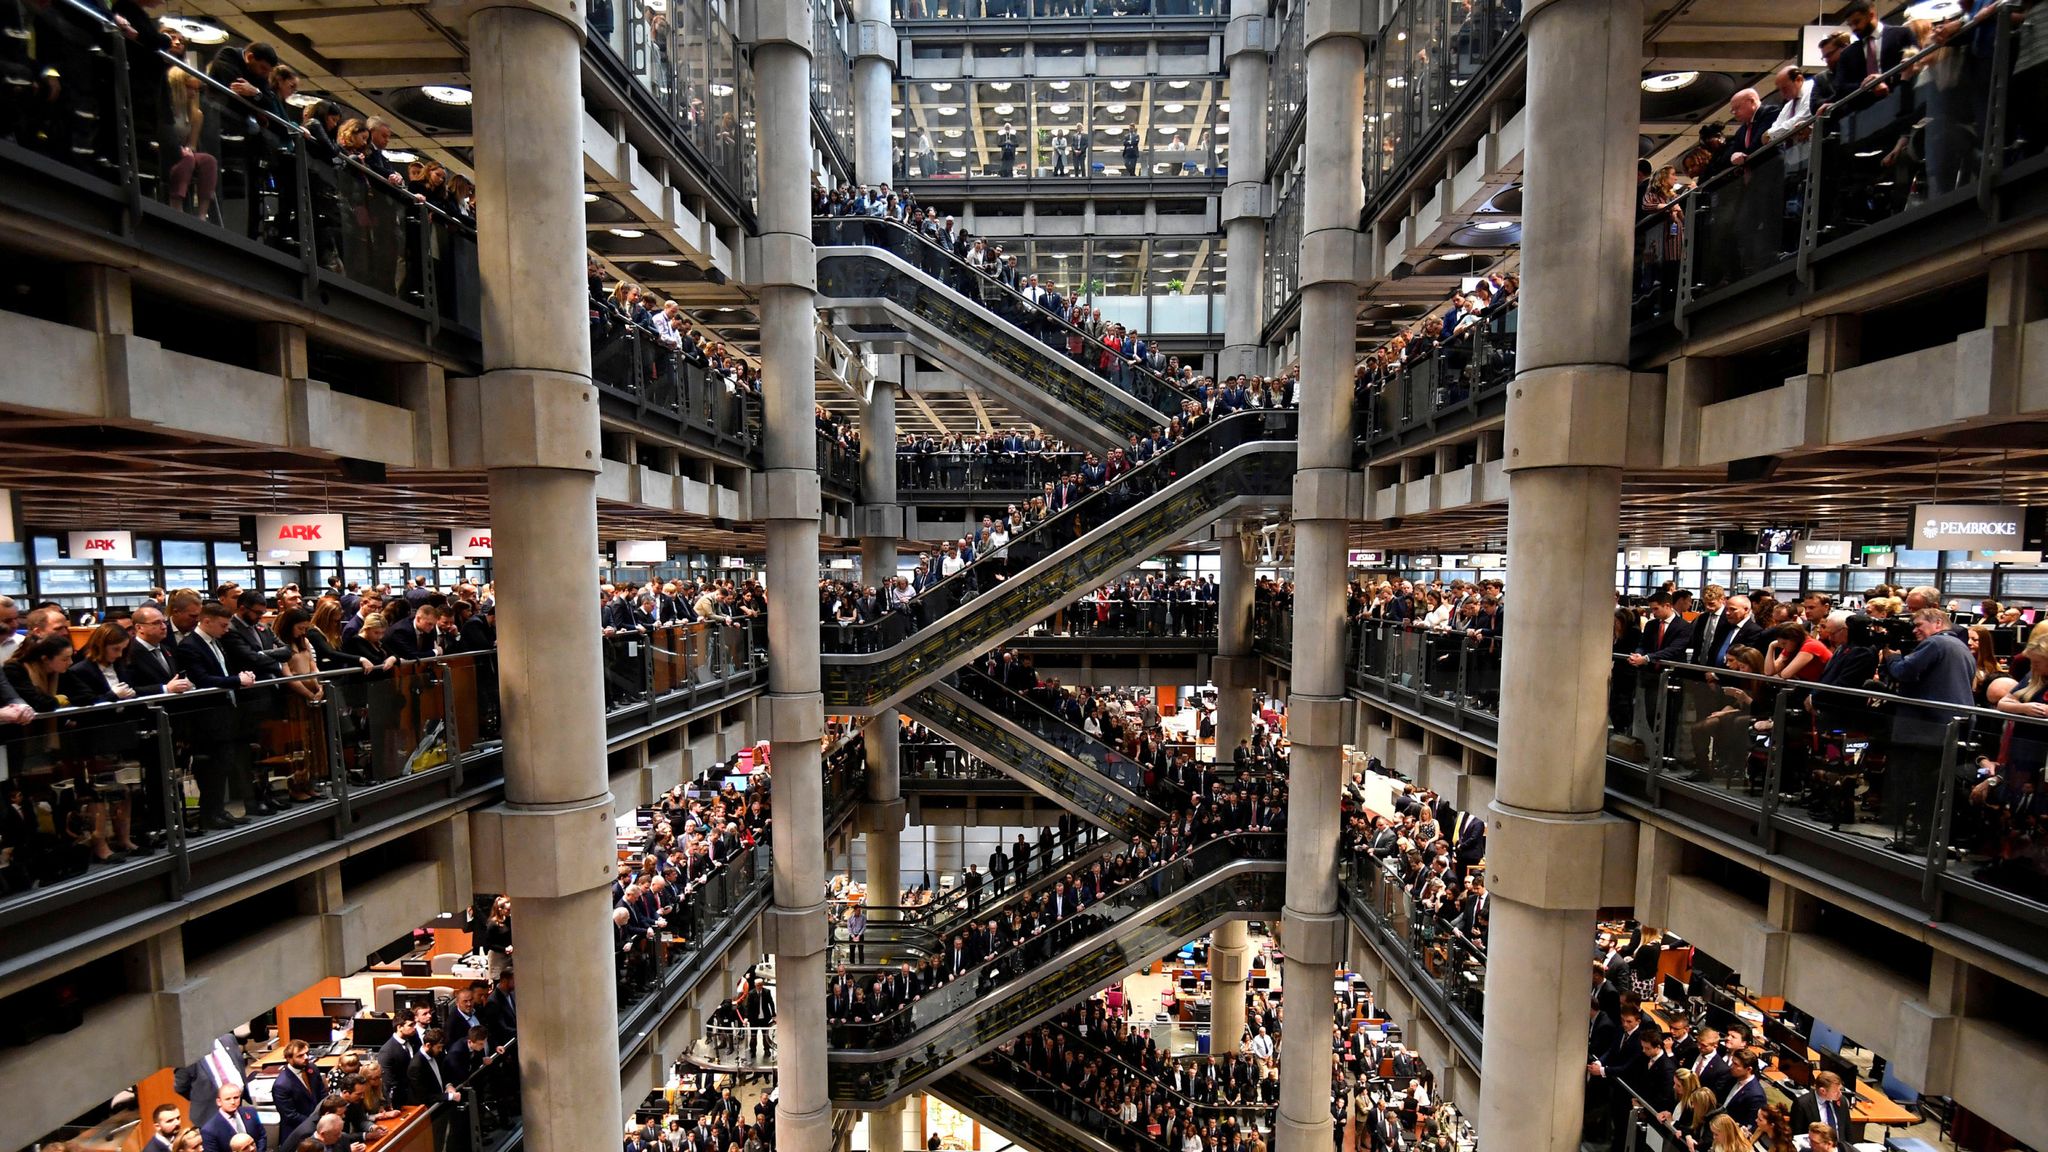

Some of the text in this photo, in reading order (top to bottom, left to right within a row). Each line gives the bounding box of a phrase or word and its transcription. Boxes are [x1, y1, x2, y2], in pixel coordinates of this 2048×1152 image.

[279, 524, 322, 540] ARK
[1940, 522, 2016, 535] PEMBROKE
[85, 539, 115, 550] ARK
[468, 536, 492, 548] AR
